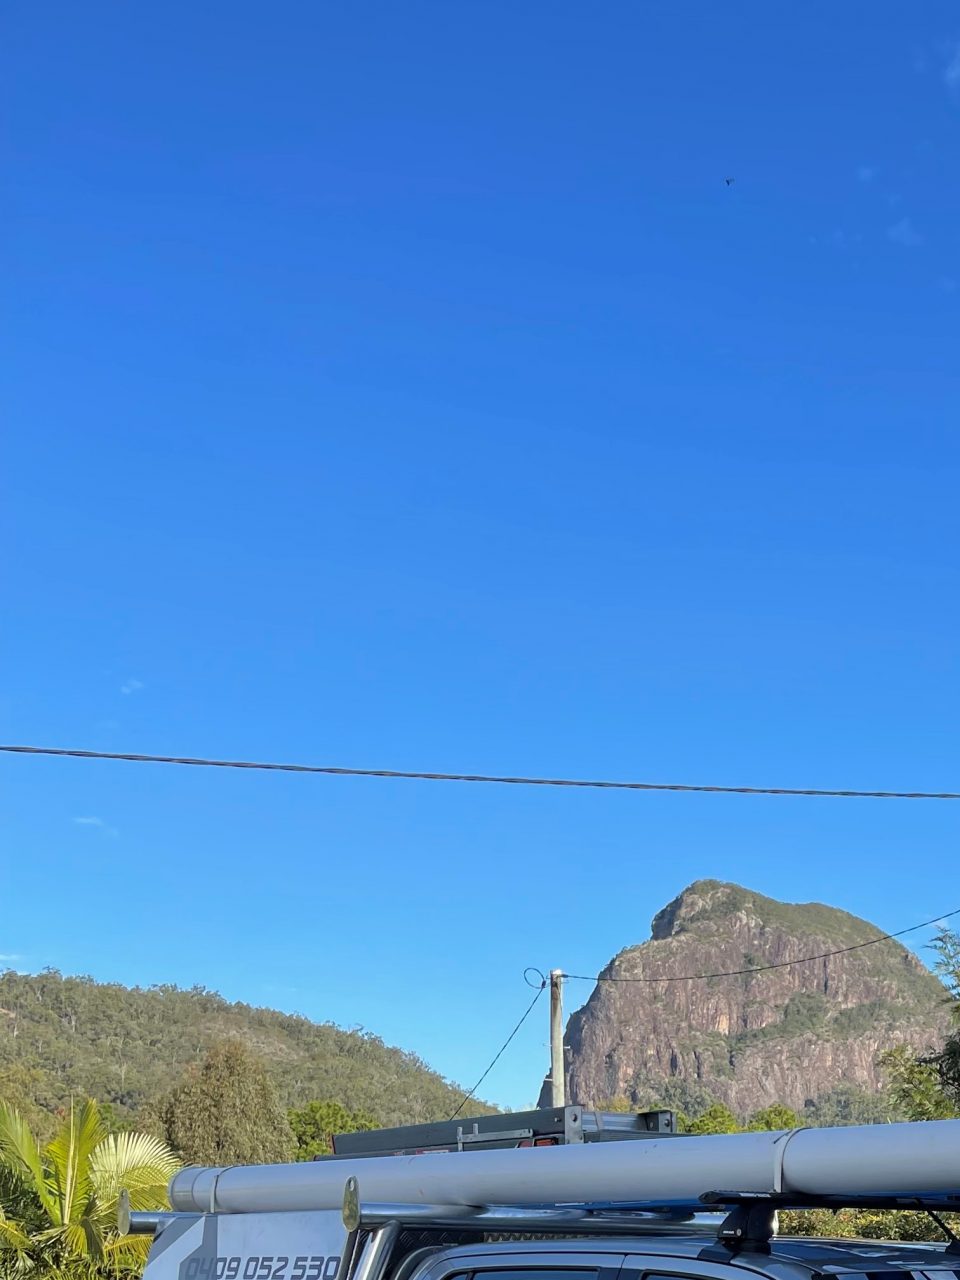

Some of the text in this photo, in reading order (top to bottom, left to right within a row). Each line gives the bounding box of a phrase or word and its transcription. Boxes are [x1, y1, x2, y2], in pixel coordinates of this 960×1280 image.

[185, 1256, 341, 1280] 0409 052 530
